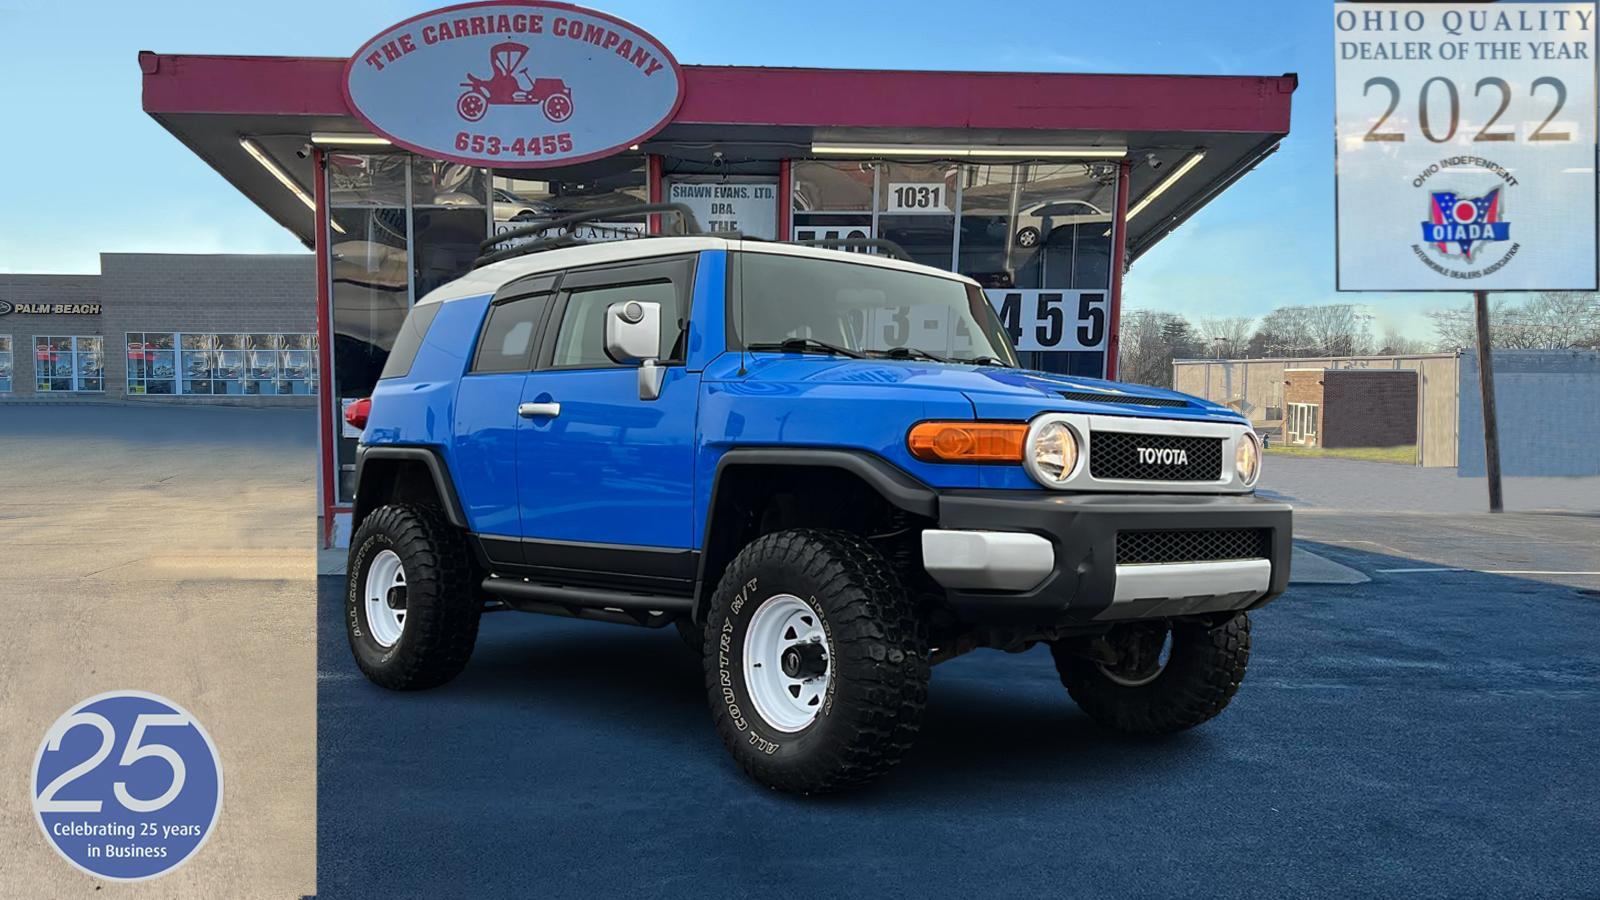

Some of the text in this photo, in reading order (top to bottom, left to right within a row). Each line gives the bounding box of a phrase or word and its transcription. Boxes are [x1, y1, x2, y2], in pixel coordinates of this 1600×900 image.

[1336, 10, 1593, 35] OHIO QUALITY
[365, 14, 664, 77] THE CARRIAGE COMPANY
[1340, 42, 1589, 60] DEALER OF THE YEAR
[1363, 76, 1571, 143] 2022
[455, 132, 574, 157] 653-4455
[1412, 155, 1519, 188] OHIO INDEPENDENT
[673, 186, 711, 198] SHAWN
[754, 187, 774, 199] LTD.
[894, 187, 940, 208] 1031
[711, 203, 735, 215] DBA.
[708, 221, 738, 232] THE
[1433, 224, 1495, 240] OIADA
[1411, 242, 1521, 280] AUTOMOBILE DEALERS ASSOCIATION
[14, 304, 101, 314] PALM BEACH
[1136, 447, 1188, 465] TOYOTA
[719, 577, 780, 755] ALL COUNTRY M/T
